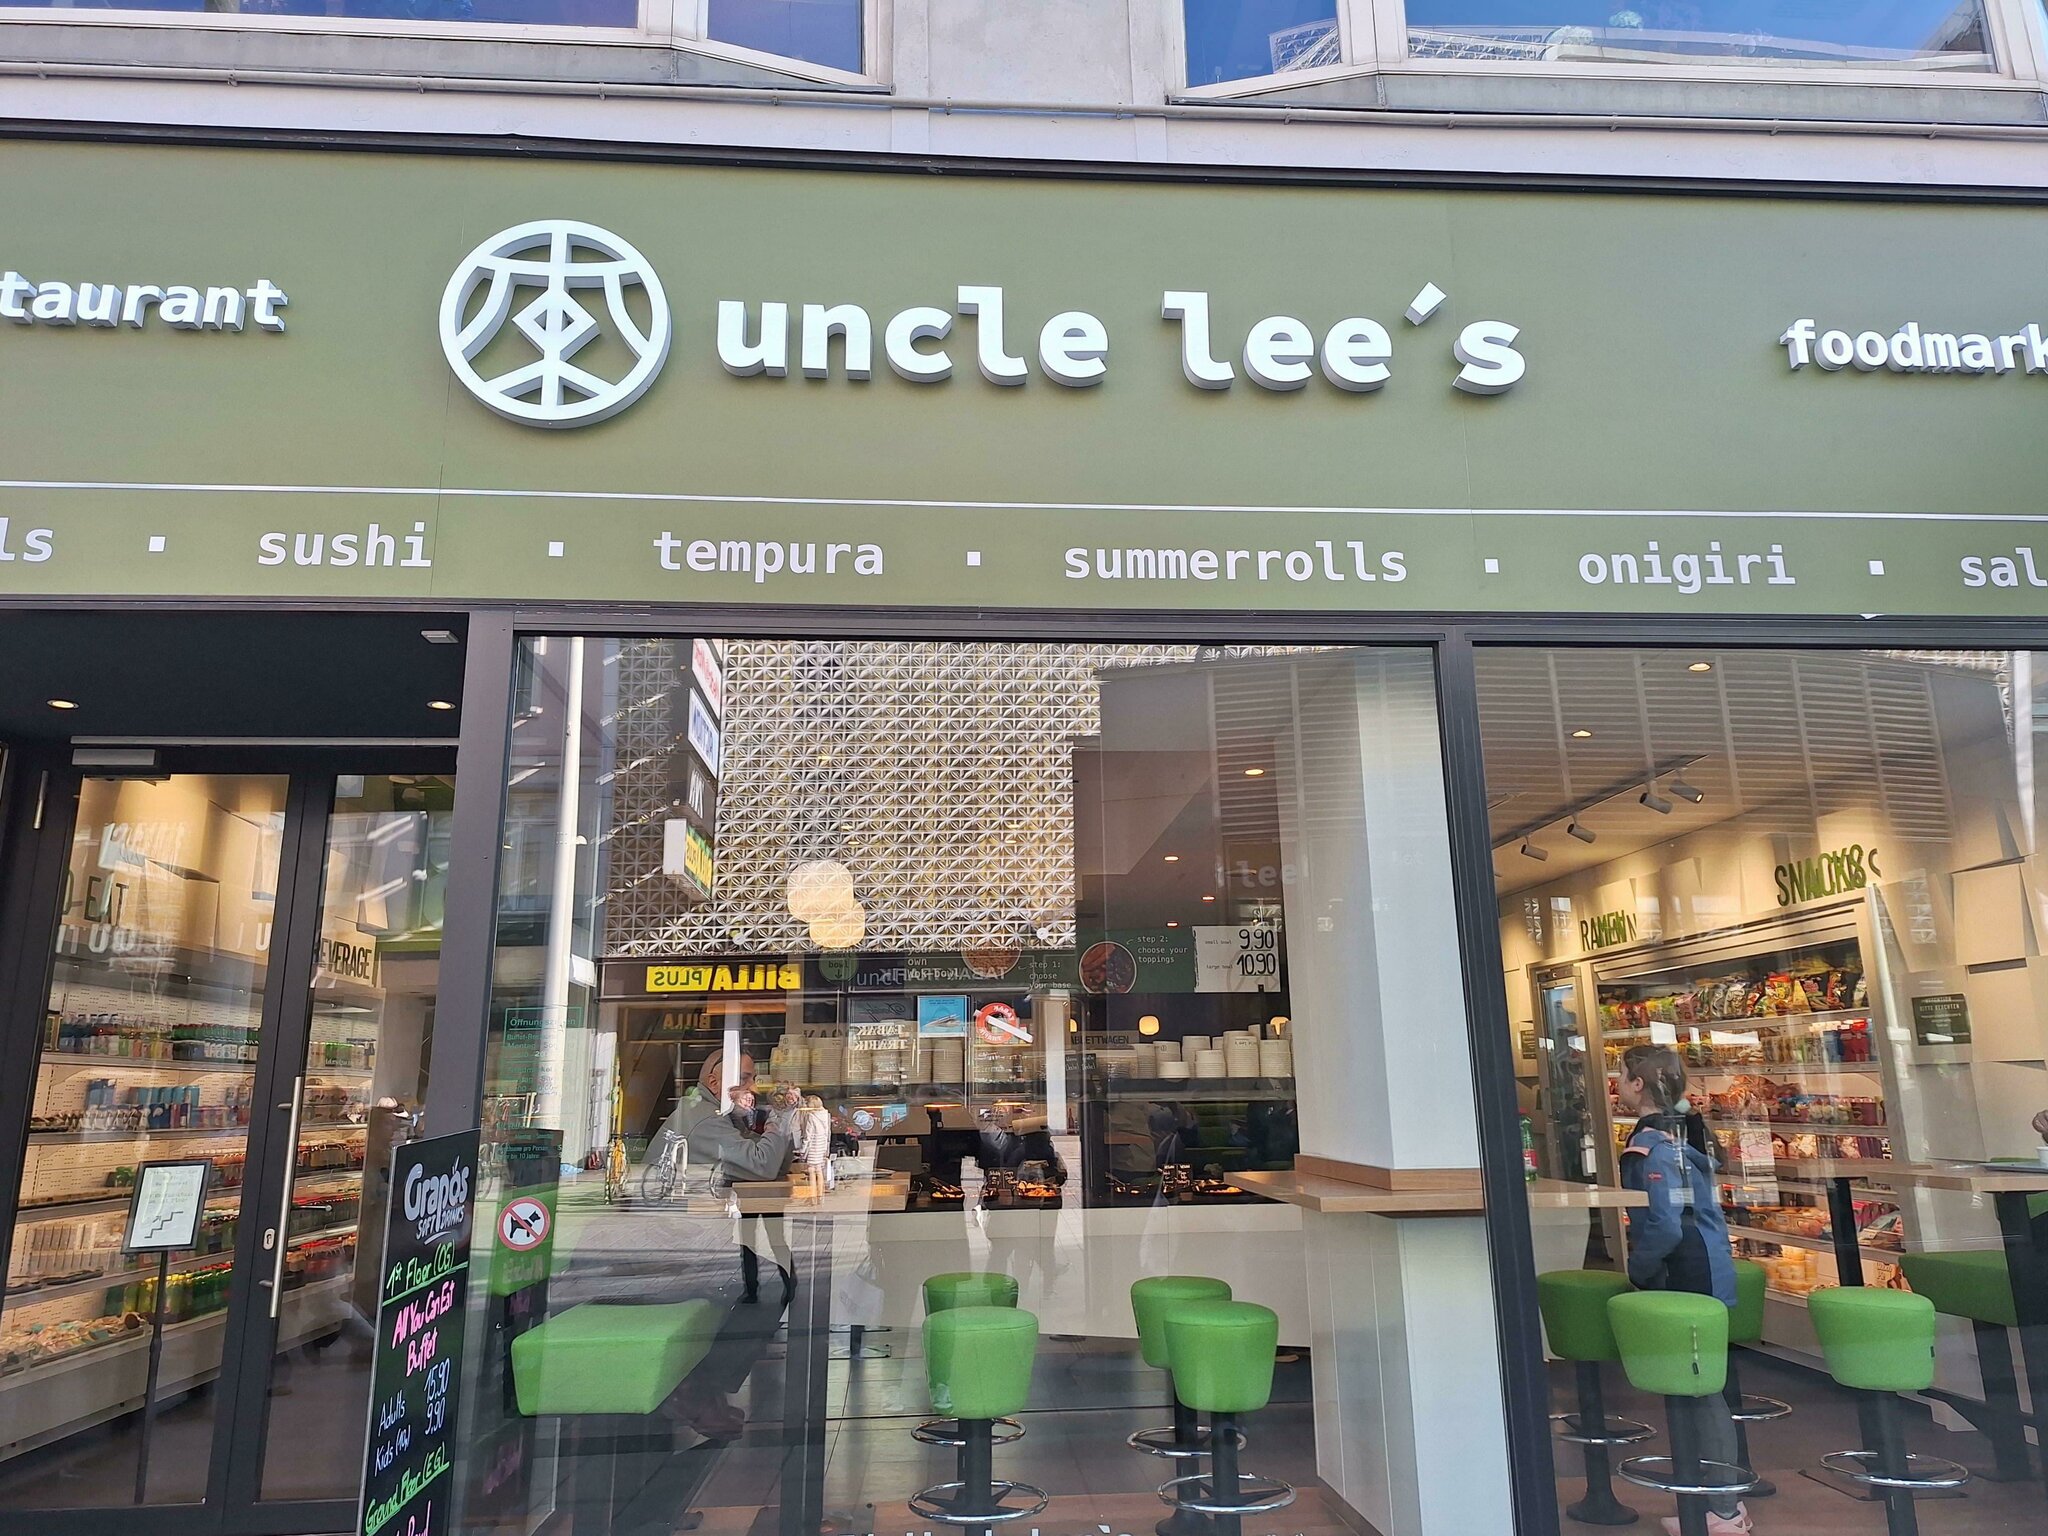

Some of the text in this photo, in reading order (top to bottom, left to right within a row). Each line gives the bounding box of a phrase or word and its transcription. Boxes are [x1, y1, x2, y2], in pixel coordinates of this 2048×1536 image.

[0, 271, 288, 333] taurant
[715, 284, 1110, 388] uncle
[257, 520, 433, 568] sushi
[653, 530, 885, 584] tempura
[1064, 540, 1408, 583] summerrolls
[1578, 541, 1797, 595] onigiri
[1960, 547, 2048, 587] sal
[1775, 844, 1868, 906] SNACKS
[1137, 934, 1169, 945] step 2:
[1137, 945, 1188, 957] choose your
[1580, 910, 1634, 951] RAMEN
[908, 957, 928, 966] own
[1029, 960, 1061, 970] step 1:
[1029, 972, 1058, 980] choose
[1138, 955, 1175, 965] toppings
[1052, 981, 1072, 989] base
[405, 1257, 432, 1290] Floor
[433, 1239, 455, 1276] (OG)
[392, 1280, 455, 1349] All You Can Eat
[406, 1327, 438, 1377] Buffet
[378, 1389, 405, 1437] Adults
[374, 1440, 394, 1477] Kids
[365, 1483, 399, 1533] Ground
[422, 1441, 446, 1480] (EG)
